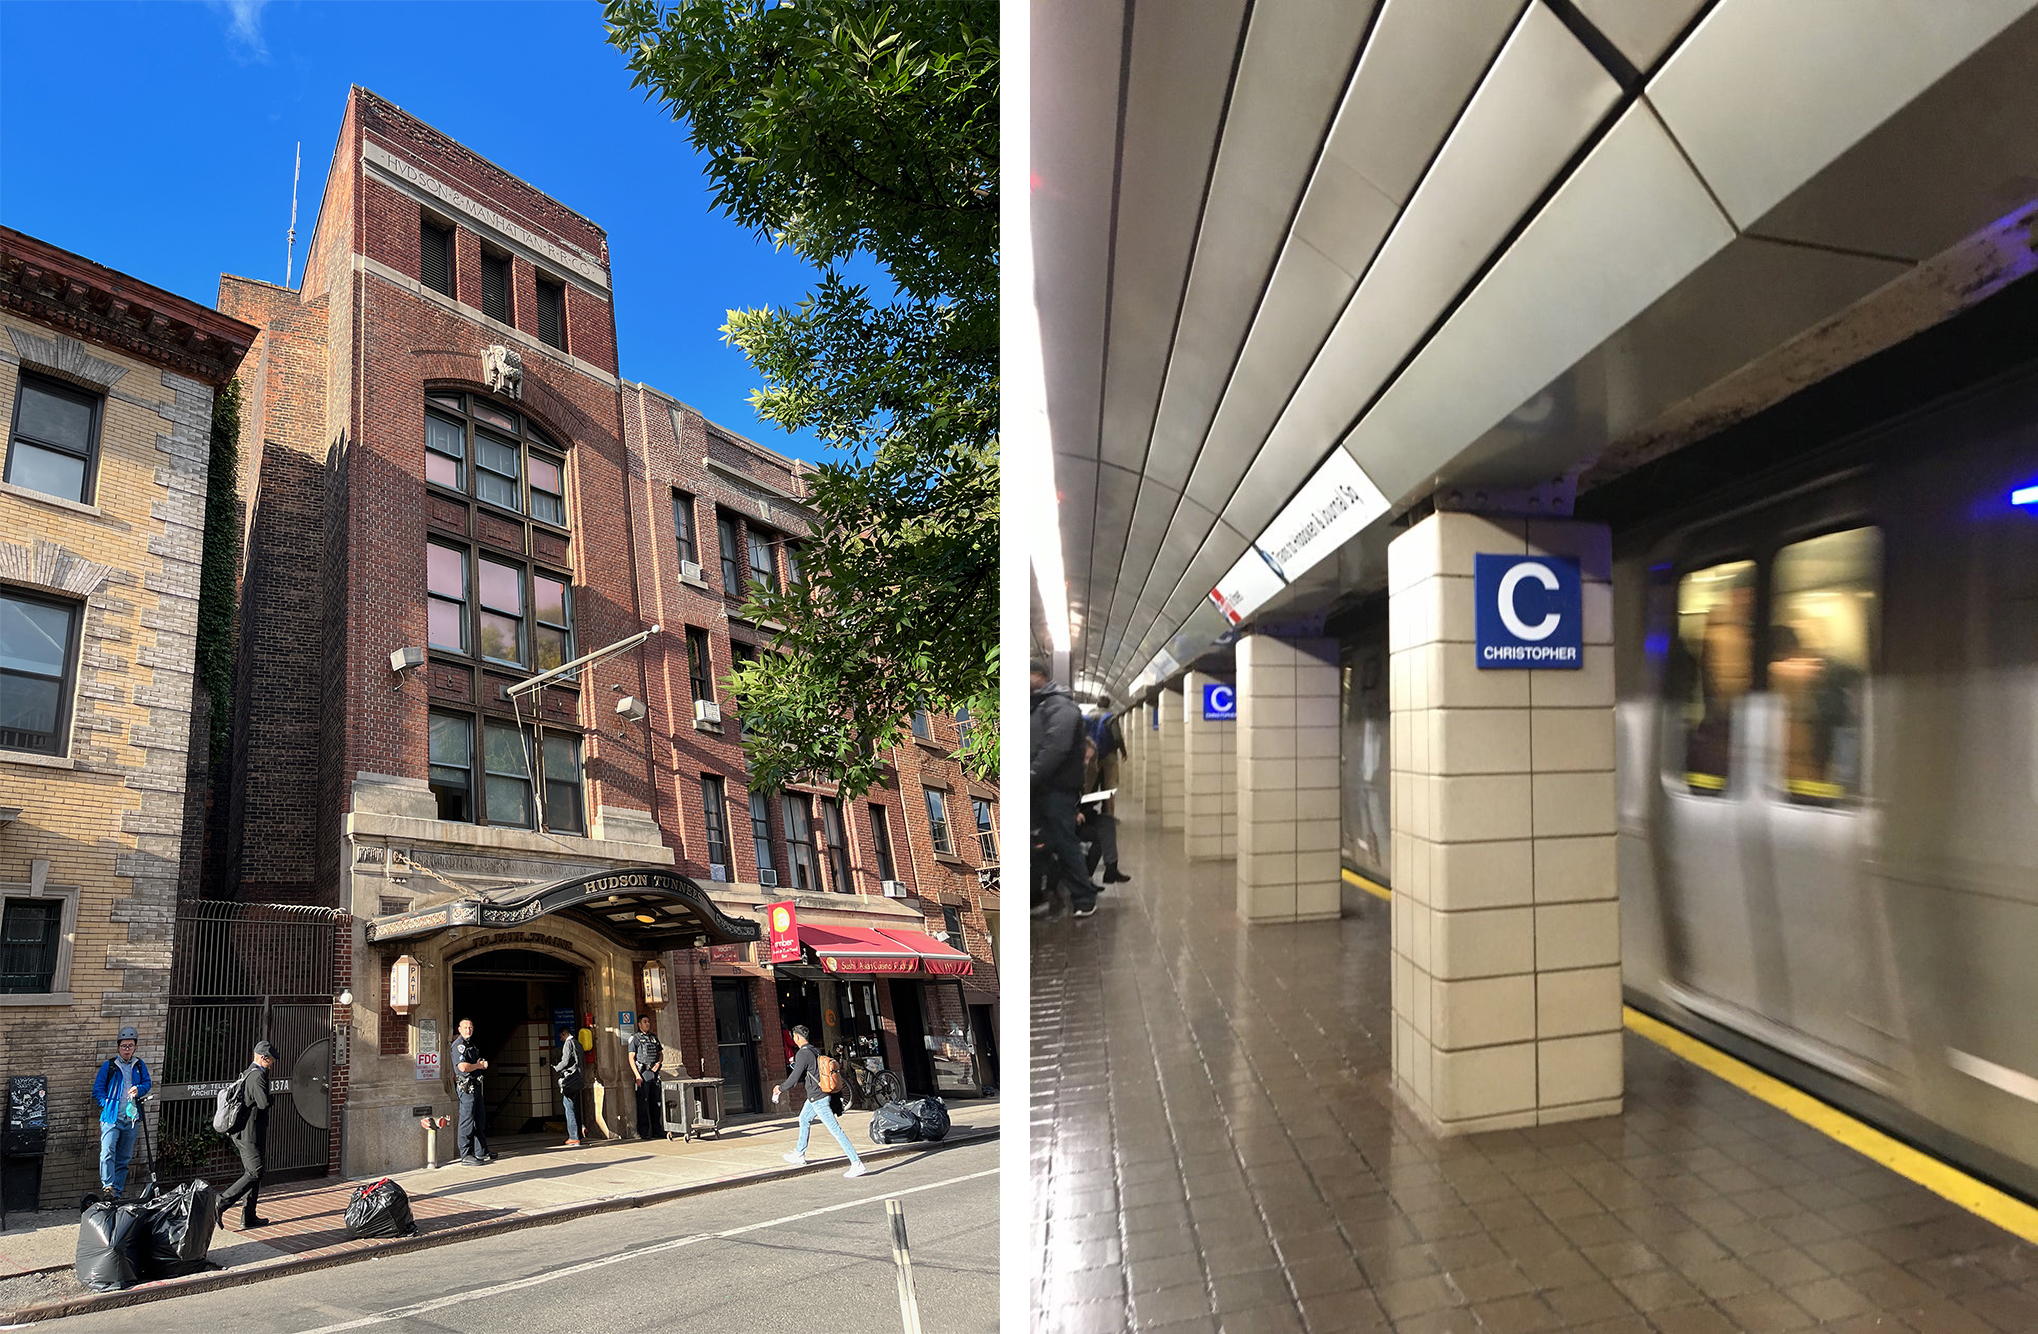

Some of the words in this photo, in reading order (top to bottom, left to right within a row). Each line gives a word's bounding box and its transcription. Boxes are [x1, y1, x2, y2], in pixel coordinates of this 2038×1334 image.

[387, 155, 448, 199] HVDSON
[452, 192, 462, 206] &
[466, 200, 544, 251] MANHATTAN
[1339, 484, 1364, 505] Sq
[1497, 561, 1562, 642] C
[1483, 645, 1577, 661] CHRISTOPHER
[1210, 685, 1234, 712] C
[583, 874, 649, 895] HUDSON
[473, 935, 491, 950] TO
[494, 931, 526, 944] PATH
[529, 931, 574, 952] TRAINS
[418, 1053, 437, 1065] FDC
[270, 1080, 289, 1091] 137A
